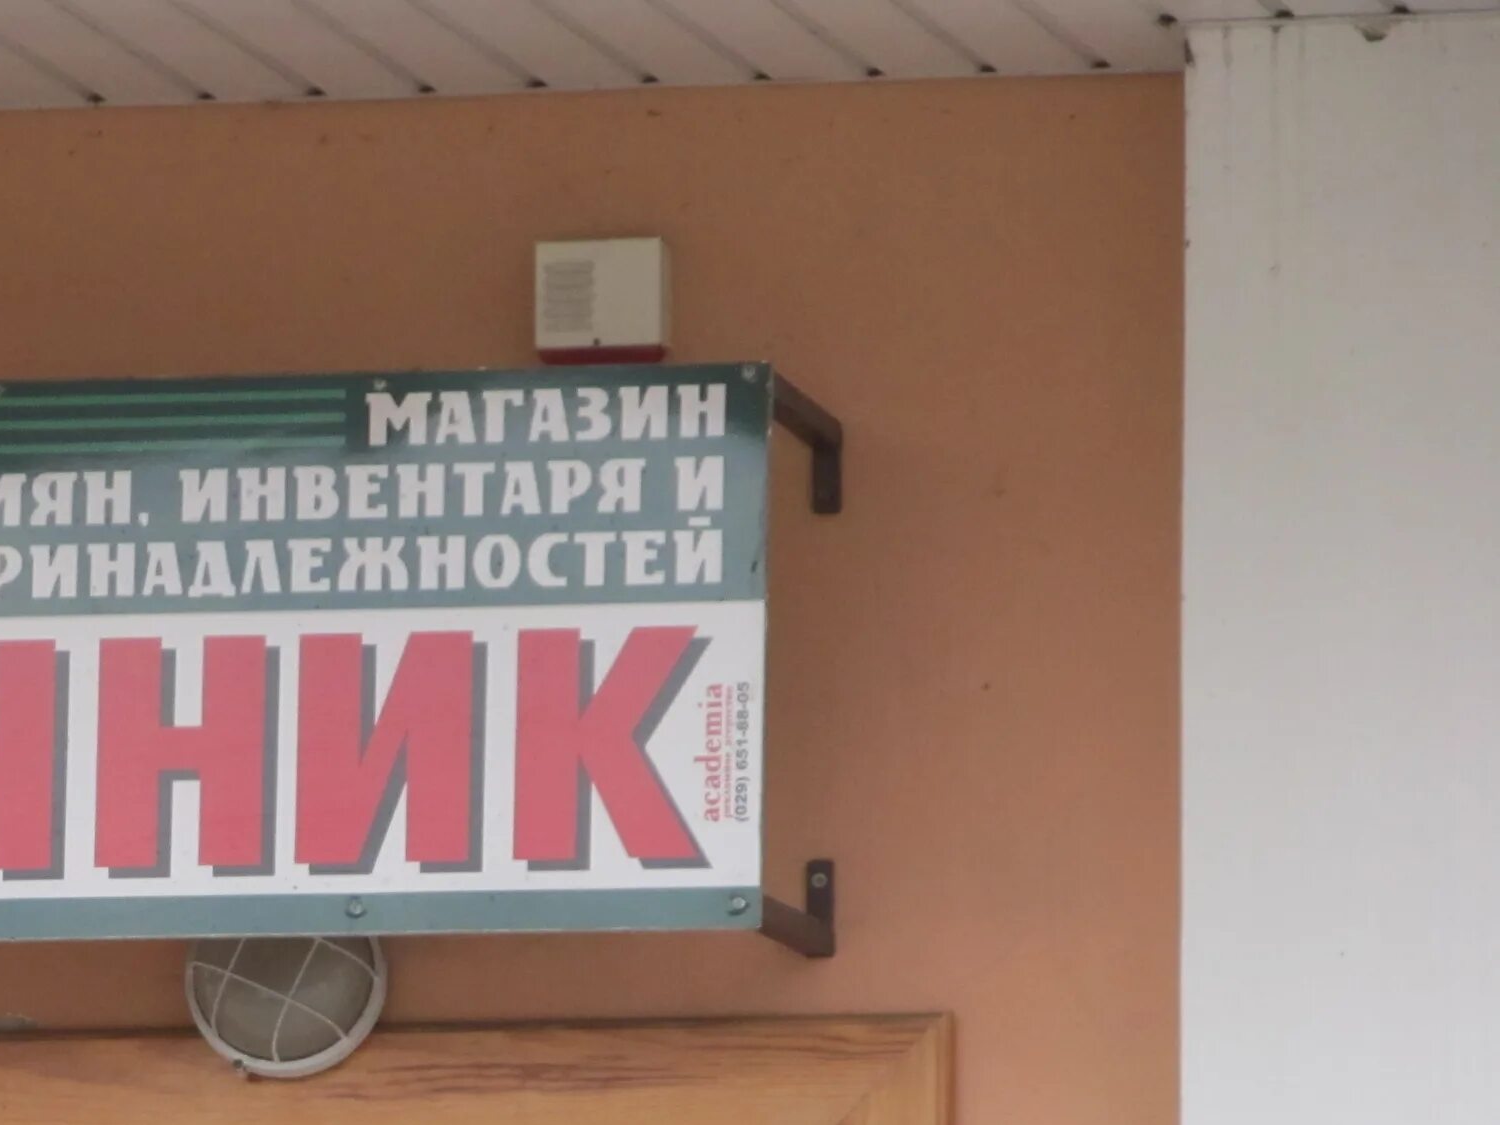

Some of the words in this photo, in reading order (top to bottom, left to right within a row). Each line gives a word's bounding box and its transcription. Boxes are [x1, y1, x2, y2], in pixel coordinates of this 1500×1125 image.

[366, 383, 728, 447] МАГАЗИН
[179, 457, 653, 526] ИНВЕНТАРЯ
[676, 455, 726, 515] И
[693, 684, 723, 822] academia
[734, 776, 750, 822] (029)
